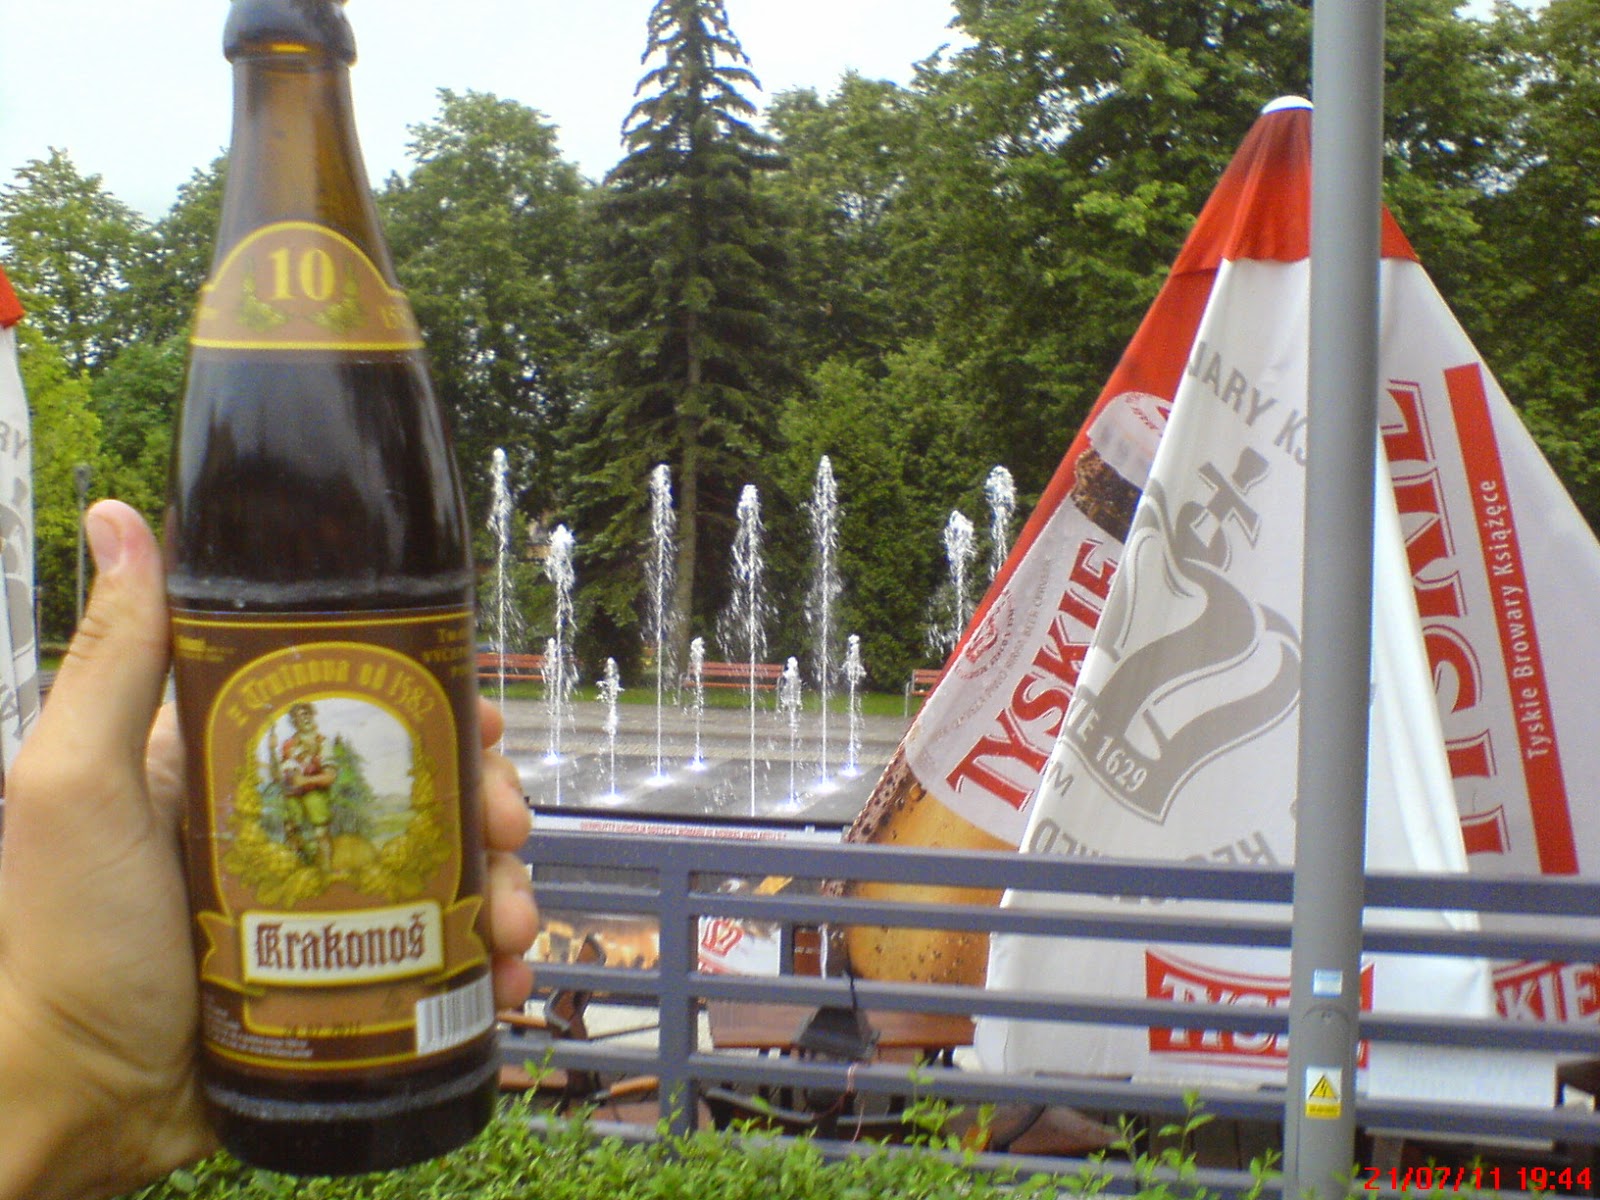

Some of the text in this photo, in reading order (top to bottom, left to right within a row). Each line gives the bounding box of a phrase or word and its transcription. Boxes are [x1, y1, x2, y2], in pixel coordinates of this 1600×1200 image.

[269, 248, 335, 301] 10
[1480, 480, 1553, 760] Tyskie Browary Książęce
[945, 538, 1117, 812] TYSKIE
[1096, 735, 1148, 792] 1629
[256, 913, 427, 970] Krakonoš
